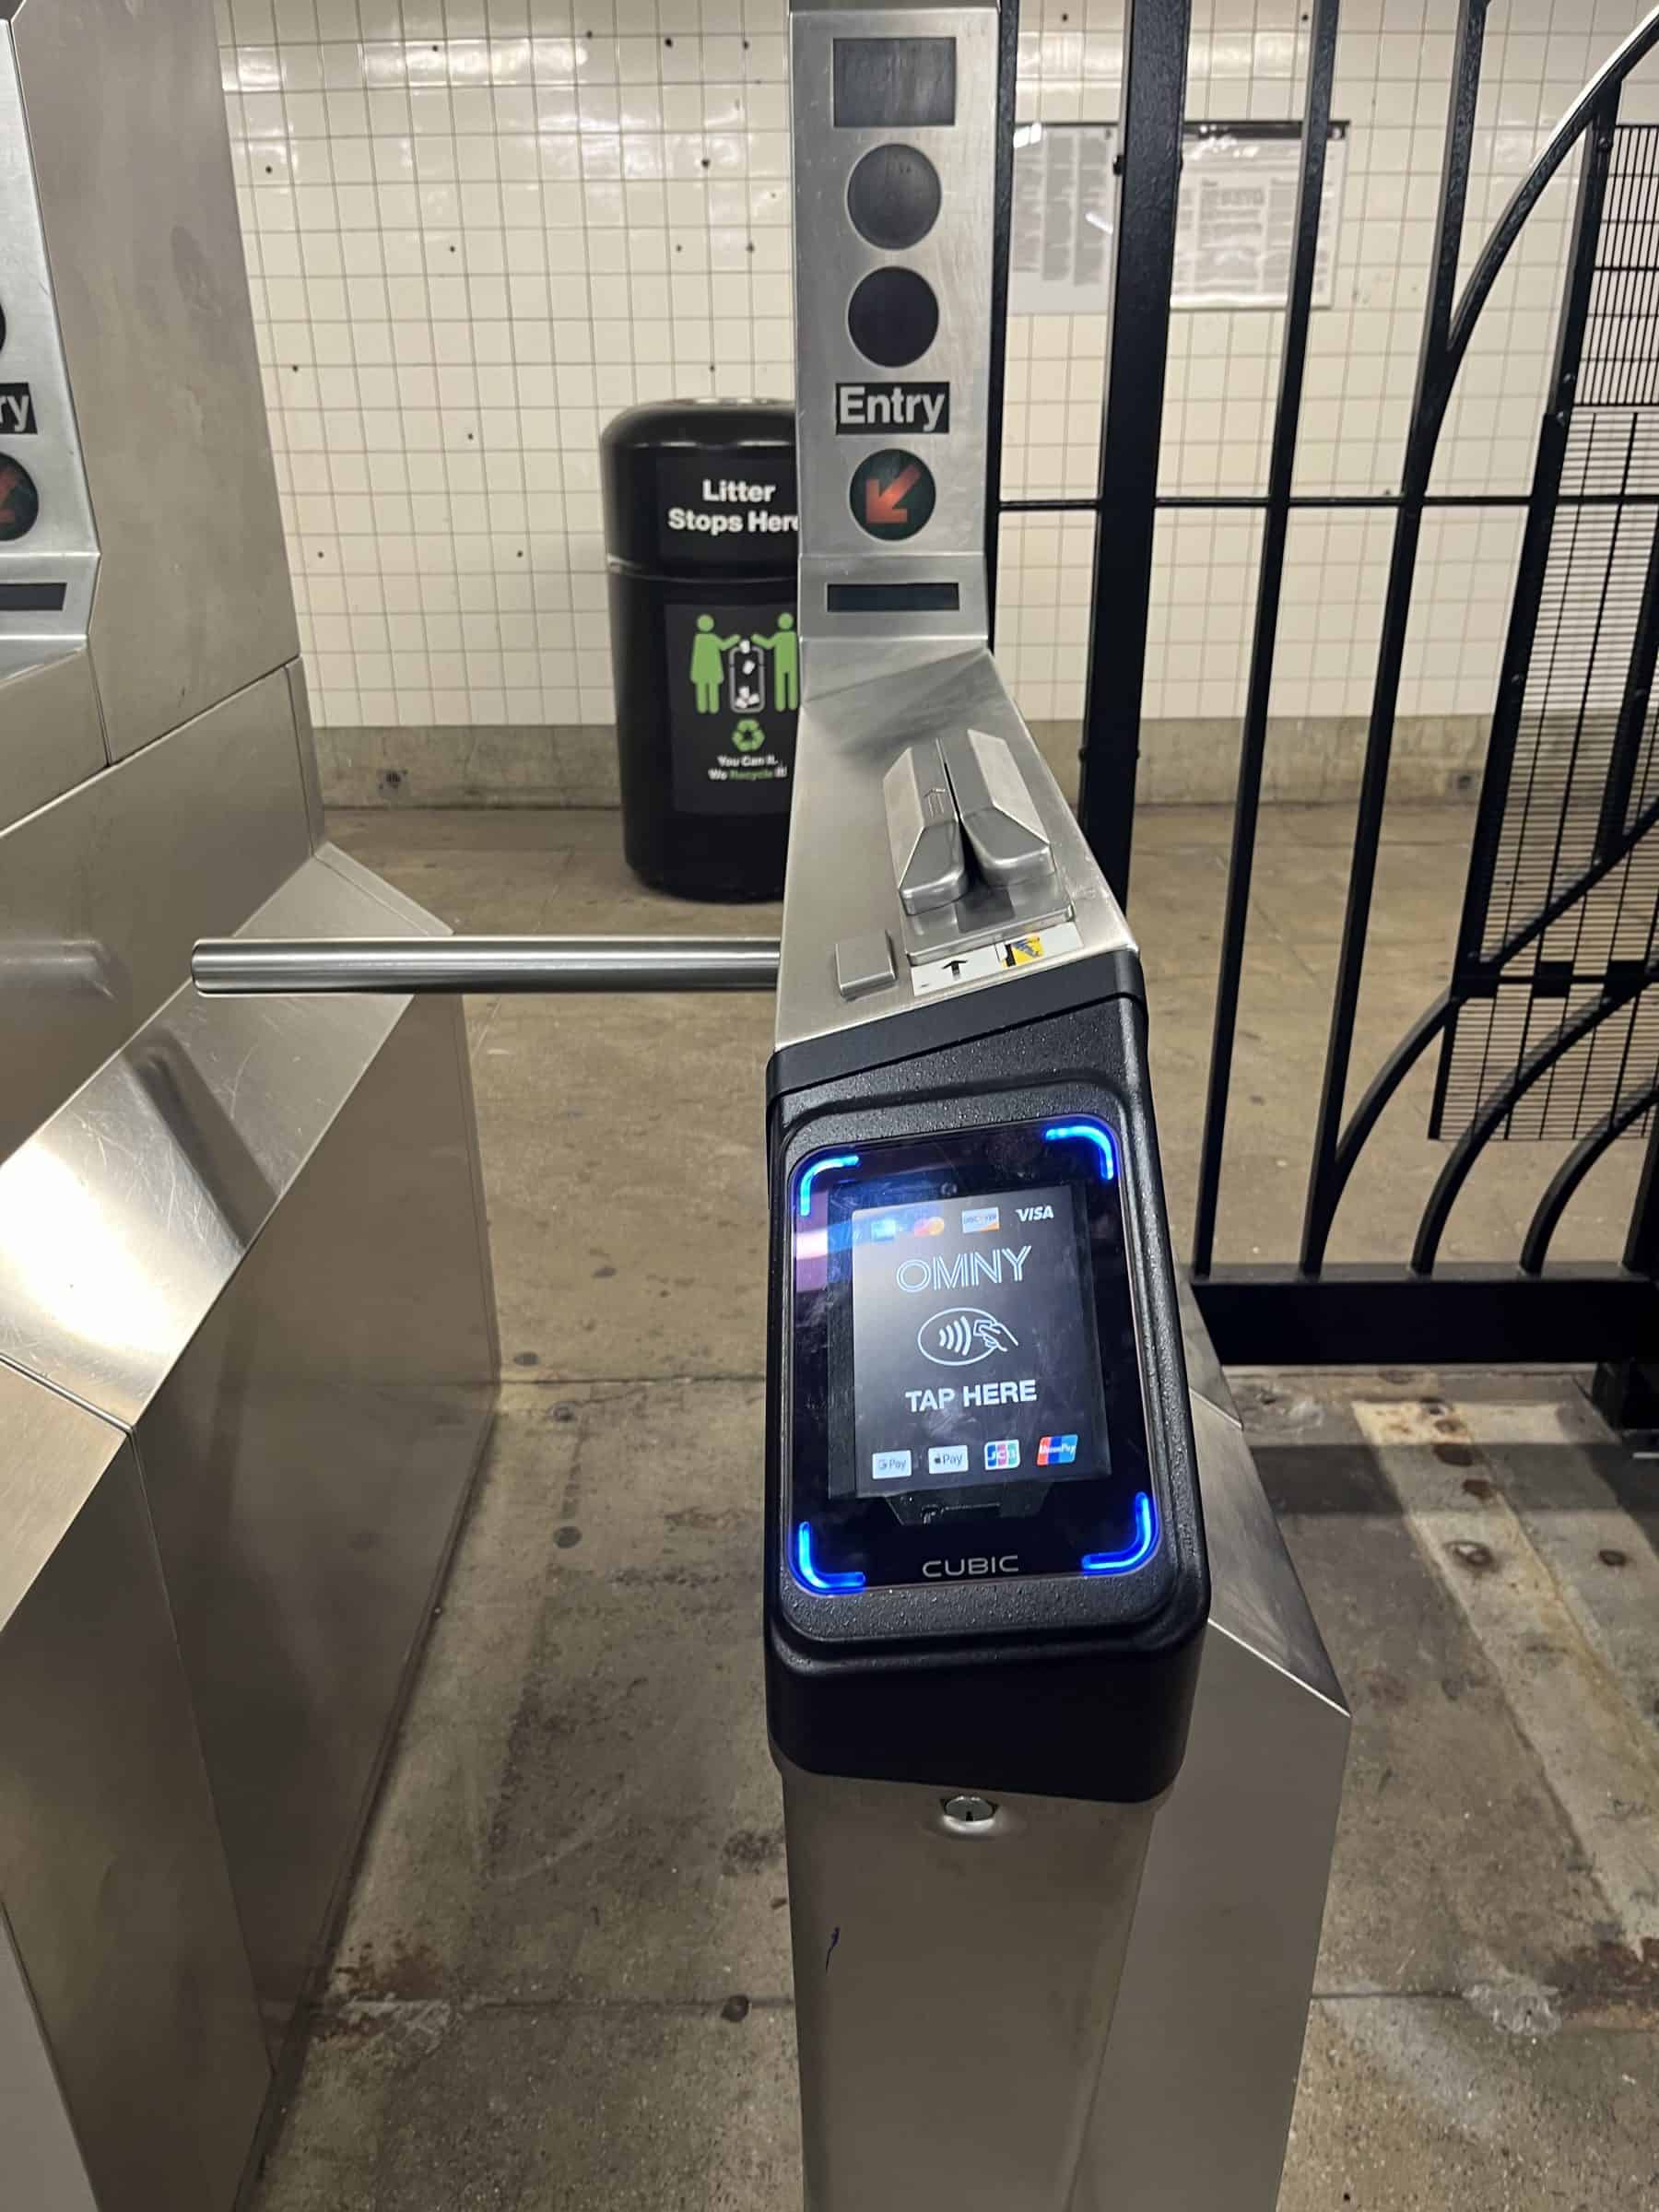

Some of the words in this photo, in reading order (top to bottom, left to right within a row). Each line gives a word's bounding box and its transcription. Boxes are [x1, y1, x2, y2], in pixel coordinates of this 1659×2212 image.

[839, 385, 945, 433] Entry
[701, 479, 776, 503] Litter
[667, 508, 744, 536] Stops
[717, 755, 740, 767] You
[740, 755, 765, 767] Can
[707, 768, 728, 781] We
[1015, 1206, 1054, 1221] VISA
[896, 1245, 1032, 1292] OMNY
[905, 1388, 956, 1413] TAP
[963, 1380, 1037, 1407] HERE
[943, 1453, 963, 1466] Pay
[922, 1555, 1019, 1578] CUBIC
